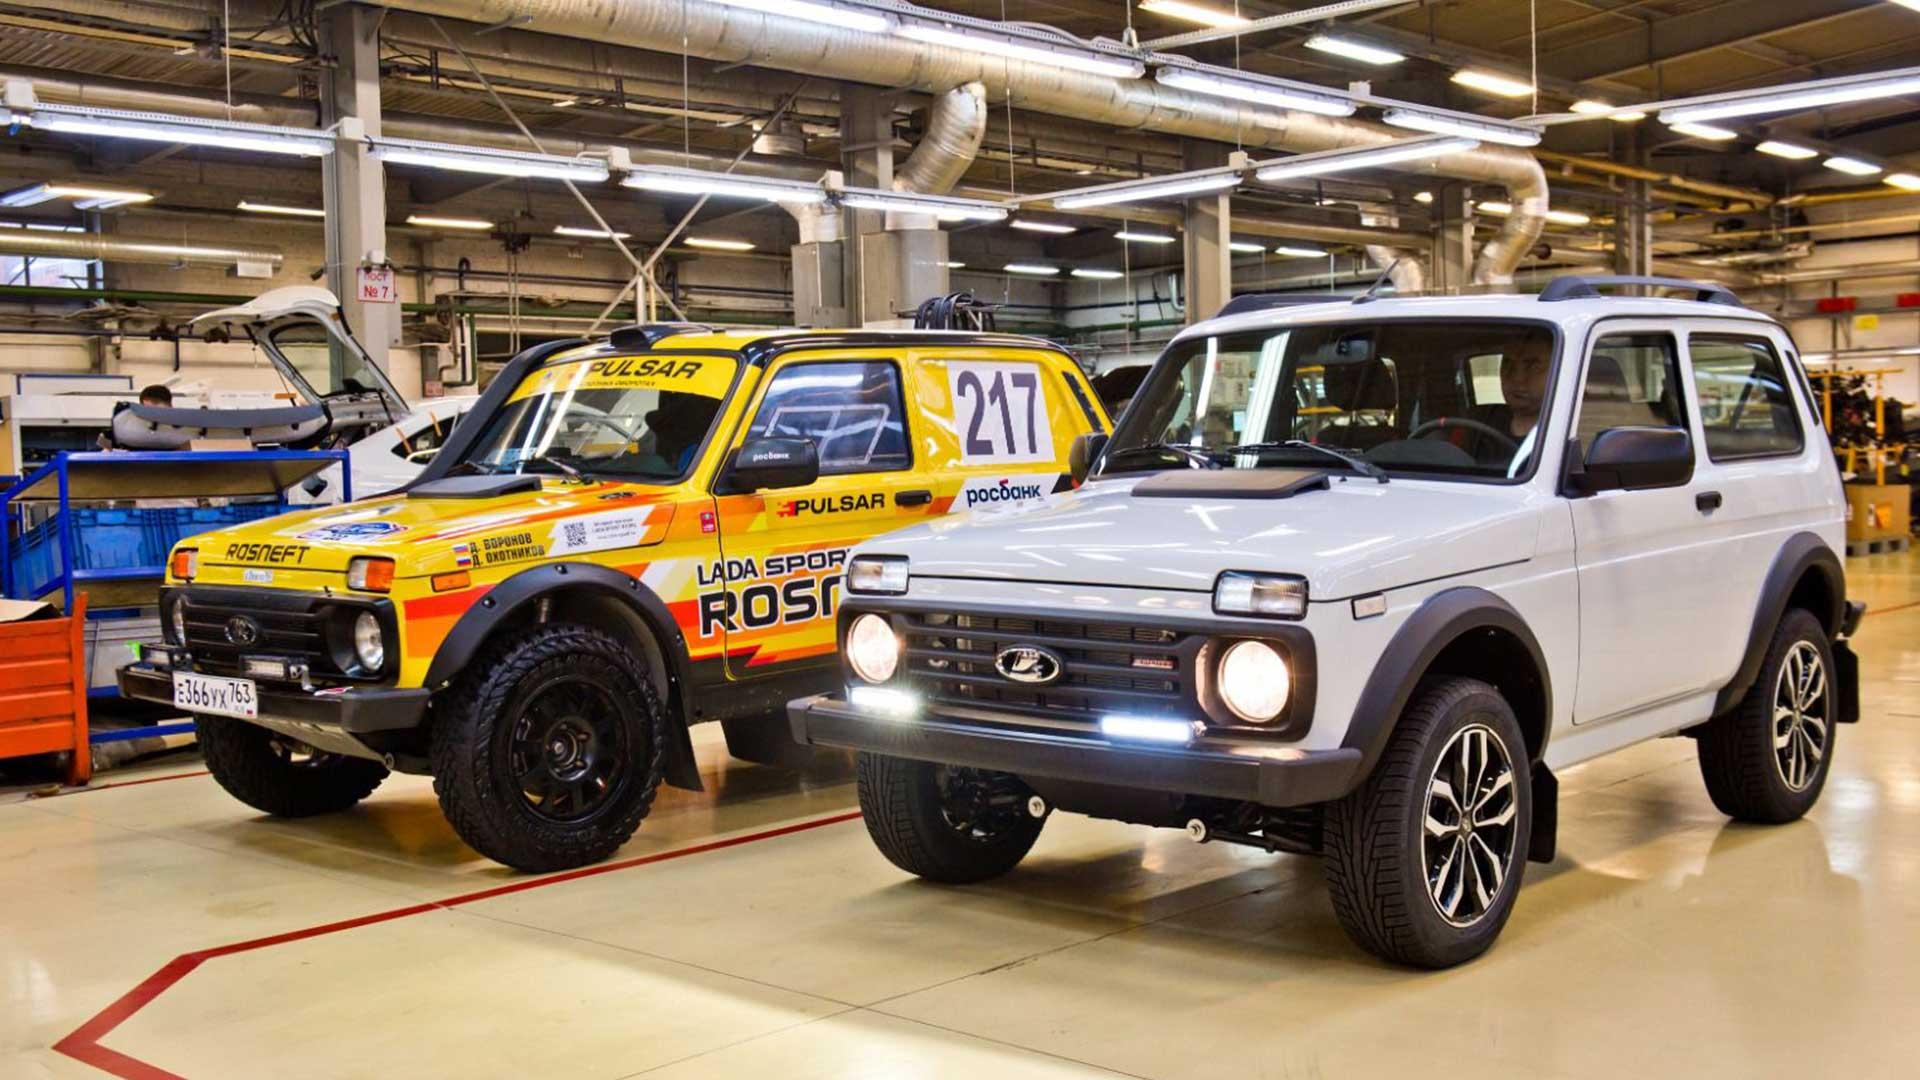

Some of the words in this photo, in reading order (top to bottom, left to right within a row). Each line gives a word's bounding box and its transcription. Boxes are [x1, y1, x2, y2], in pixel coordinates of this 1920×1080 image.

[382, 286, 388, 299] 7
[590, 360, 702, 379] PULSAR
[957, 370, 1037, 455] 217
[966, 479, 1041, 508] росбанк
[794, 494, 885, 516] PULSAR
[225, 543, 310, 564] ROSNEFT
[697, 558, 759, 585] LADA
[765, 549, 850, 576] SPOR
